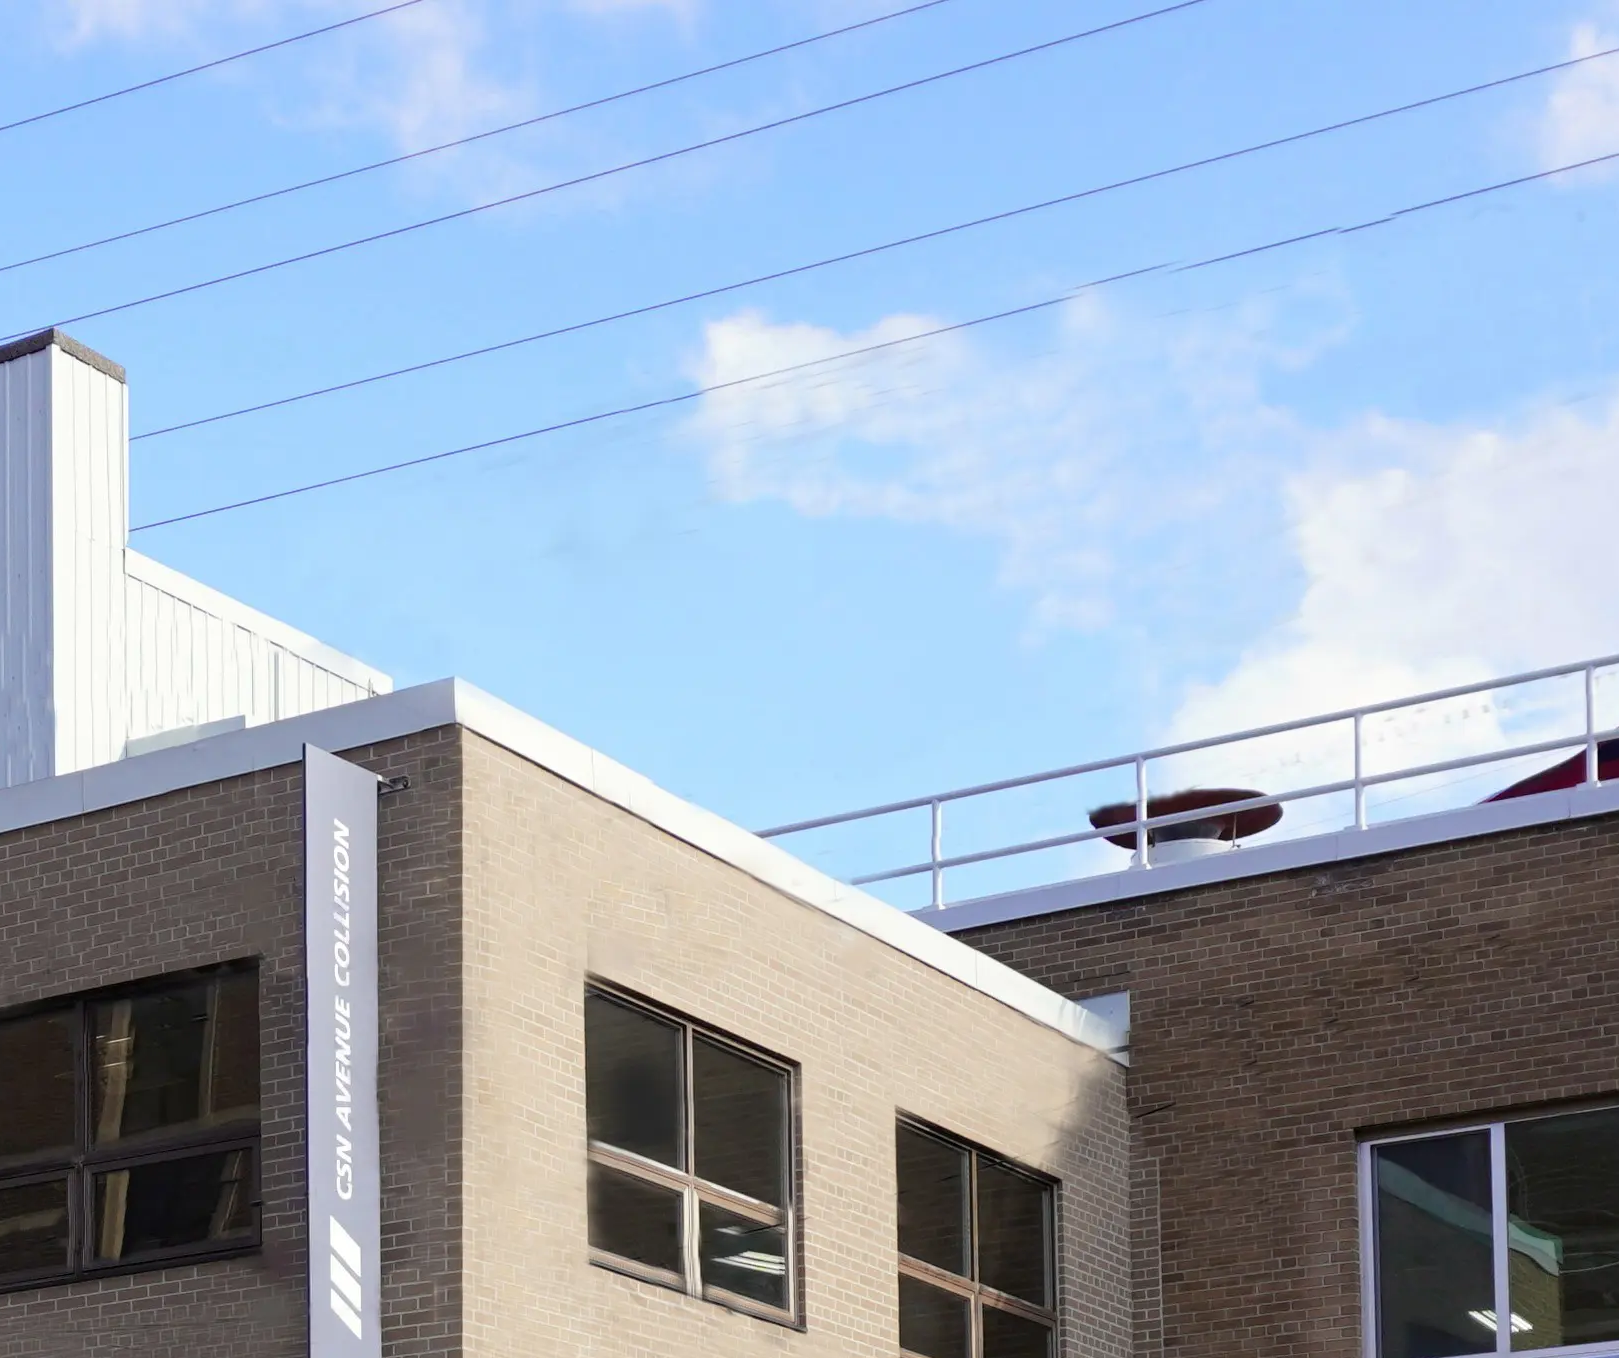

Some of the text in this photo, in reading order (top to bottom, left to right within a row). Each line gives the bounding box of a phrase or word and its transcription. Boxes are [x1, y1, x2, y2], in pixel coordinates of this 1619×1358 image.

[333, 818, 353, 1200] CSN AVENUE COLLISION
